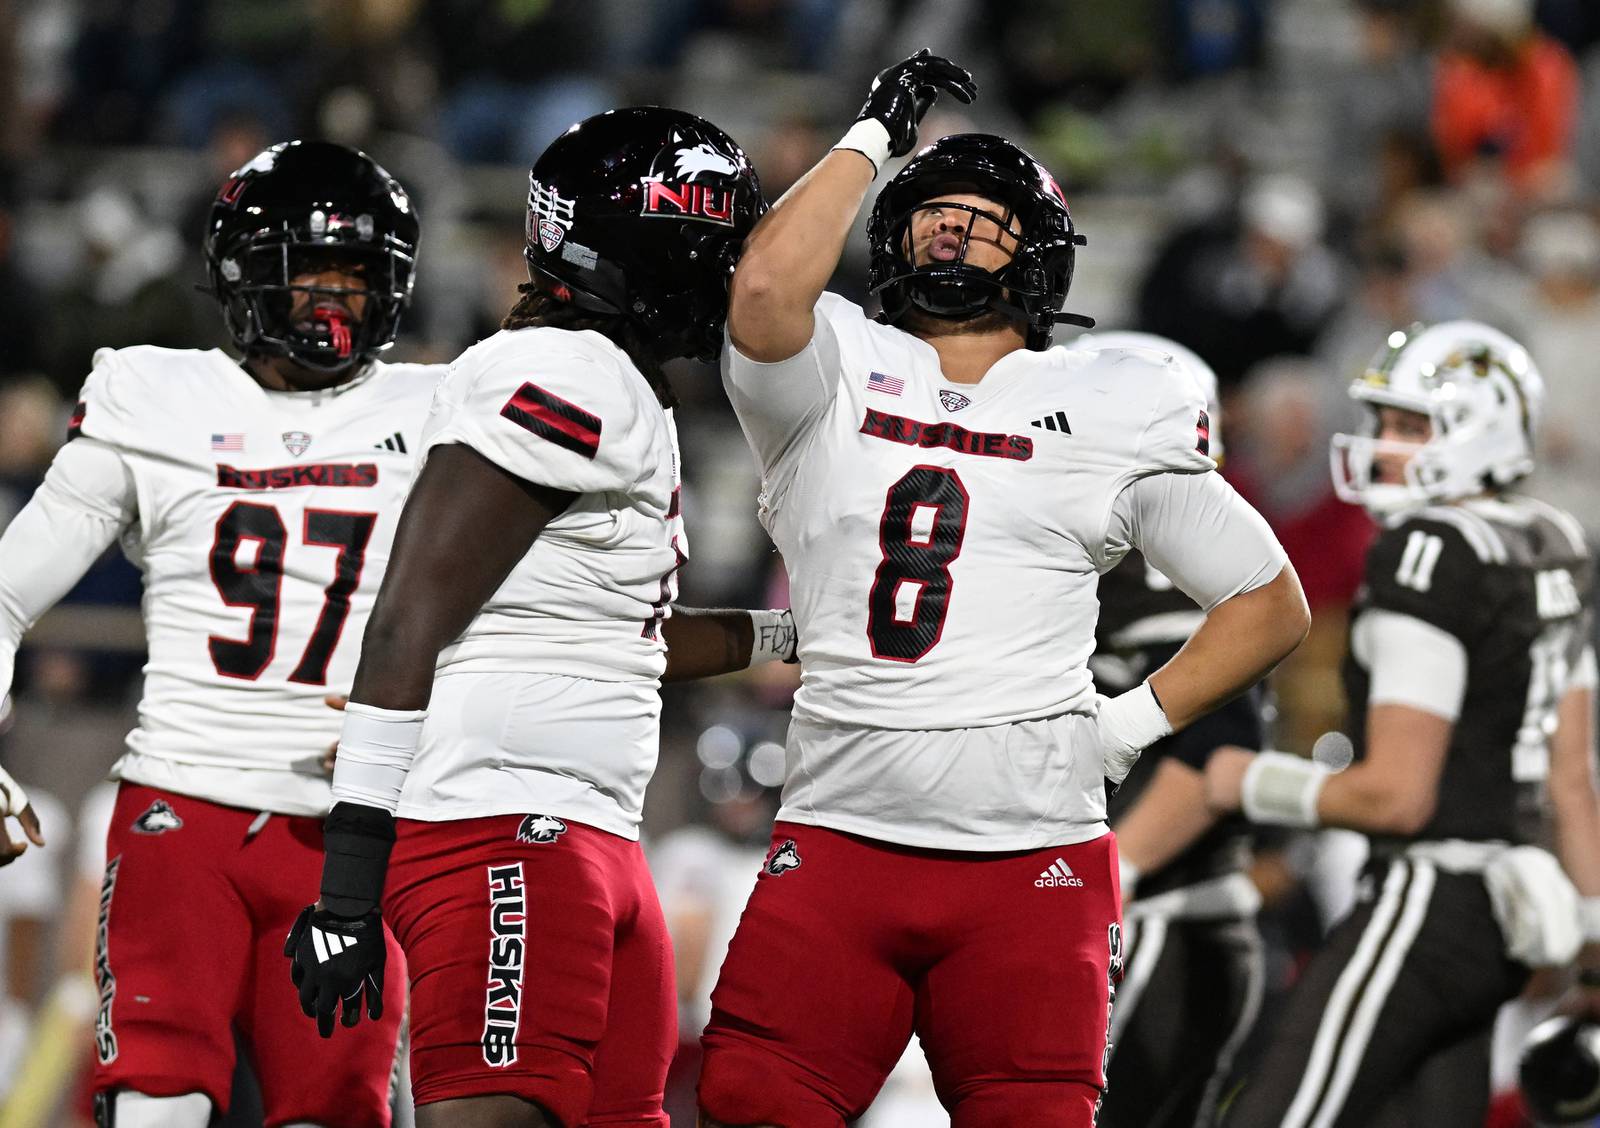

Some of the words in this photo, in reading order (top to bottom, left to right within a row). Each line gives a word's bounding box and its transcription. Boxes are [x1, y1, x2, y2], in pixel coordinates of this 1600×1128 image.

[649, 182, 731, 219] NIU
[859, 407, 1034, 462] HUSKIES
[216, 463, 379, 490] HUSKIES
[866, 464, 970, 663] 8
[1395, 529, 1443, 592] 11
[207, 499, 379, 687] 97
[1034, 876, 1084, 888] adidas
